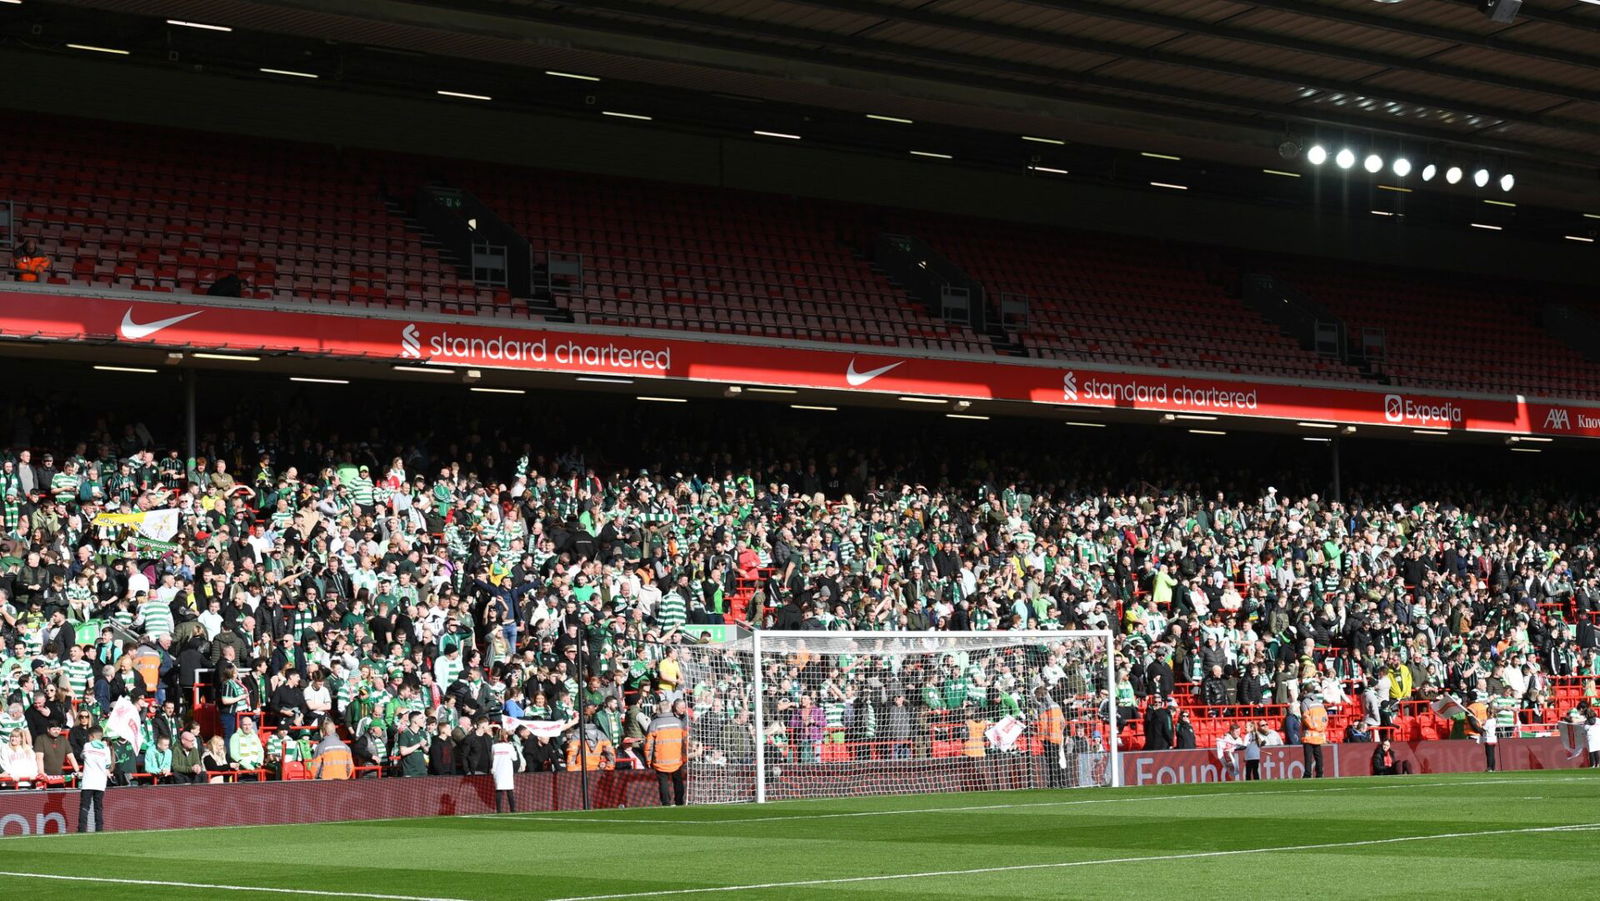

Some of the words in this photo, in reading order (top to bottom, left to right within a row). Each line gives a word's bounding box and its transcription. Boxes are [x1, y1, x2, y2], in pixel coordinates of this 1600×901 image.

[430, 332, 547, 362] standard
[555, 341, 671, 370] chartered
[1083, 378, 1168, 403] standard
[1173, 385, 1257, 409] chartered
[1405, 399, 1462, 424] Expedia
[1543, 408, 1571, 430] AXA
[1136, 751, 1319, 785] Foundtio
